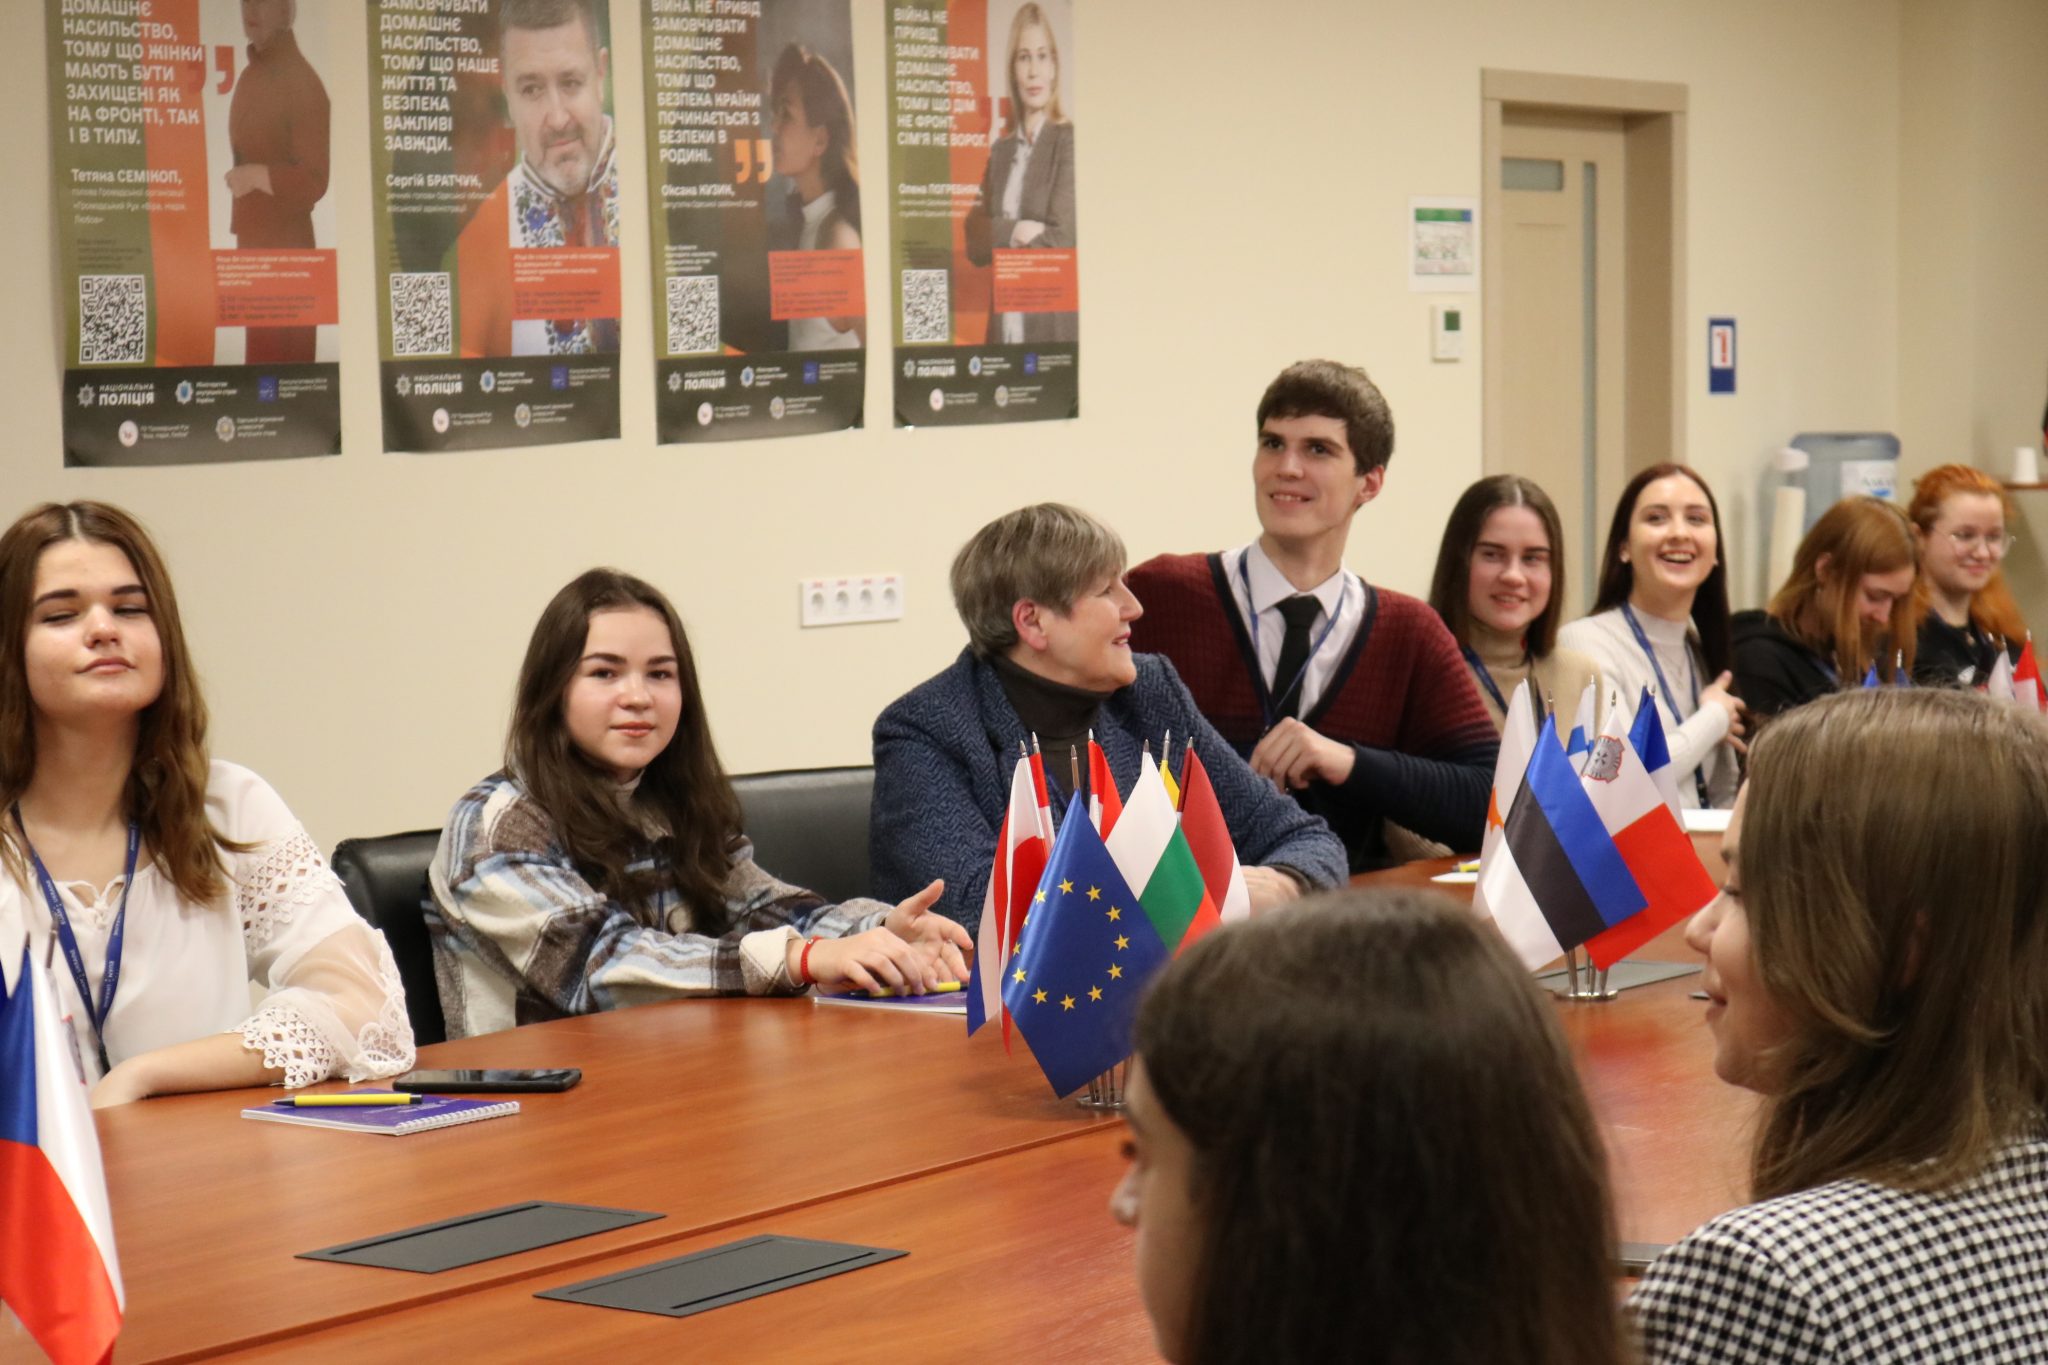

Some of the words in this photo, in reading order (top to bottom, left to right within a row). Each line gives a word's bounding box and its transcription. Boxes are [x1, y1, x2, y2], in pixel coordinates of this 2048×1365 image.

[380, 14, 462, 32] ДОМАШНЄ
[893, 5, 930, 22] ВІЙНА
[932, 10, 948, 24] НЕ
[63, 19, 178, 41] НАСИЛЬСТВО,
[652, 17, 747, 34] ЗАМОВЧУВАТИ
[64, 41, 110, 57] ТОМУ
[116, 42, 144, 60] ЩО
[148, 45, 203, 62] ЖІНКИ
[381, 35, 482, 55] НАСИЛЬСТВО,
[653, 36, 724, 52] ДОМАШНЄ
[65, 62, 128, 80] МАЮТЬ
[133, 64, 175, 82] БУТИ
[381, 54, 425, 71] ТОМУ
[430, 56, 454, 74] ЩО
[457, 57, 499, 74] НАШЕ
[655, 55, 741, 72] НАСИЛЬСТВО,
[382, 75, 436, 92] ЖИТТЯ
[439, 76, 457, 92] ТА
[656, 73, 692, 88] ТОМУ
[694, 74, 716, 90] ЩО
[66, 84, 153, 104] ЗАХИЩЕНІ
[158, 87, 181, 104] ЯК
[657, 92, 712, 107] БЕЗПЕКА
[382, 95, 449, 111] БЕЗПЕКА
[896, 96, 929, 111] ТОМУ
[932, 98, 951, 112] ЩО
[68, 106, 91, 122] НА
[95, 107, 164, 126] ФРОНТІ,
[167, 108, 200, 125] ТАК
[383, 115, 453, 132] ВАЖЛИВІ
[658, 111, 749, 126] ПОЧИНАЄТЬСЯ
[752, 112, 761, 126] З
[897, 114, 913, 127] НЕ
[79, 127, 90, 144] В
[93, 127, 141, 145] ТИЛУ.
[384, 135, 452, 154] ЗАВЖДИ.
[659, 130, 716, 144] БЕЗПЕКИ
[718, 130, 727, 144] В
[932, 132, 948, 146] НЕ
[660, 148, 712, 165] РОДИНІ.
[71, 168, 115, 183] Тетяна
[117, 169, 183, 185] СЕМІКОП,
[386, 173, 425, 189] Сергій
[1716, 328, 1728, 364] 1
[414, 381, 463, 396] ПОЛІЦІЯ
[98, 392, 155, 407] ПОЛІЦІЯ
